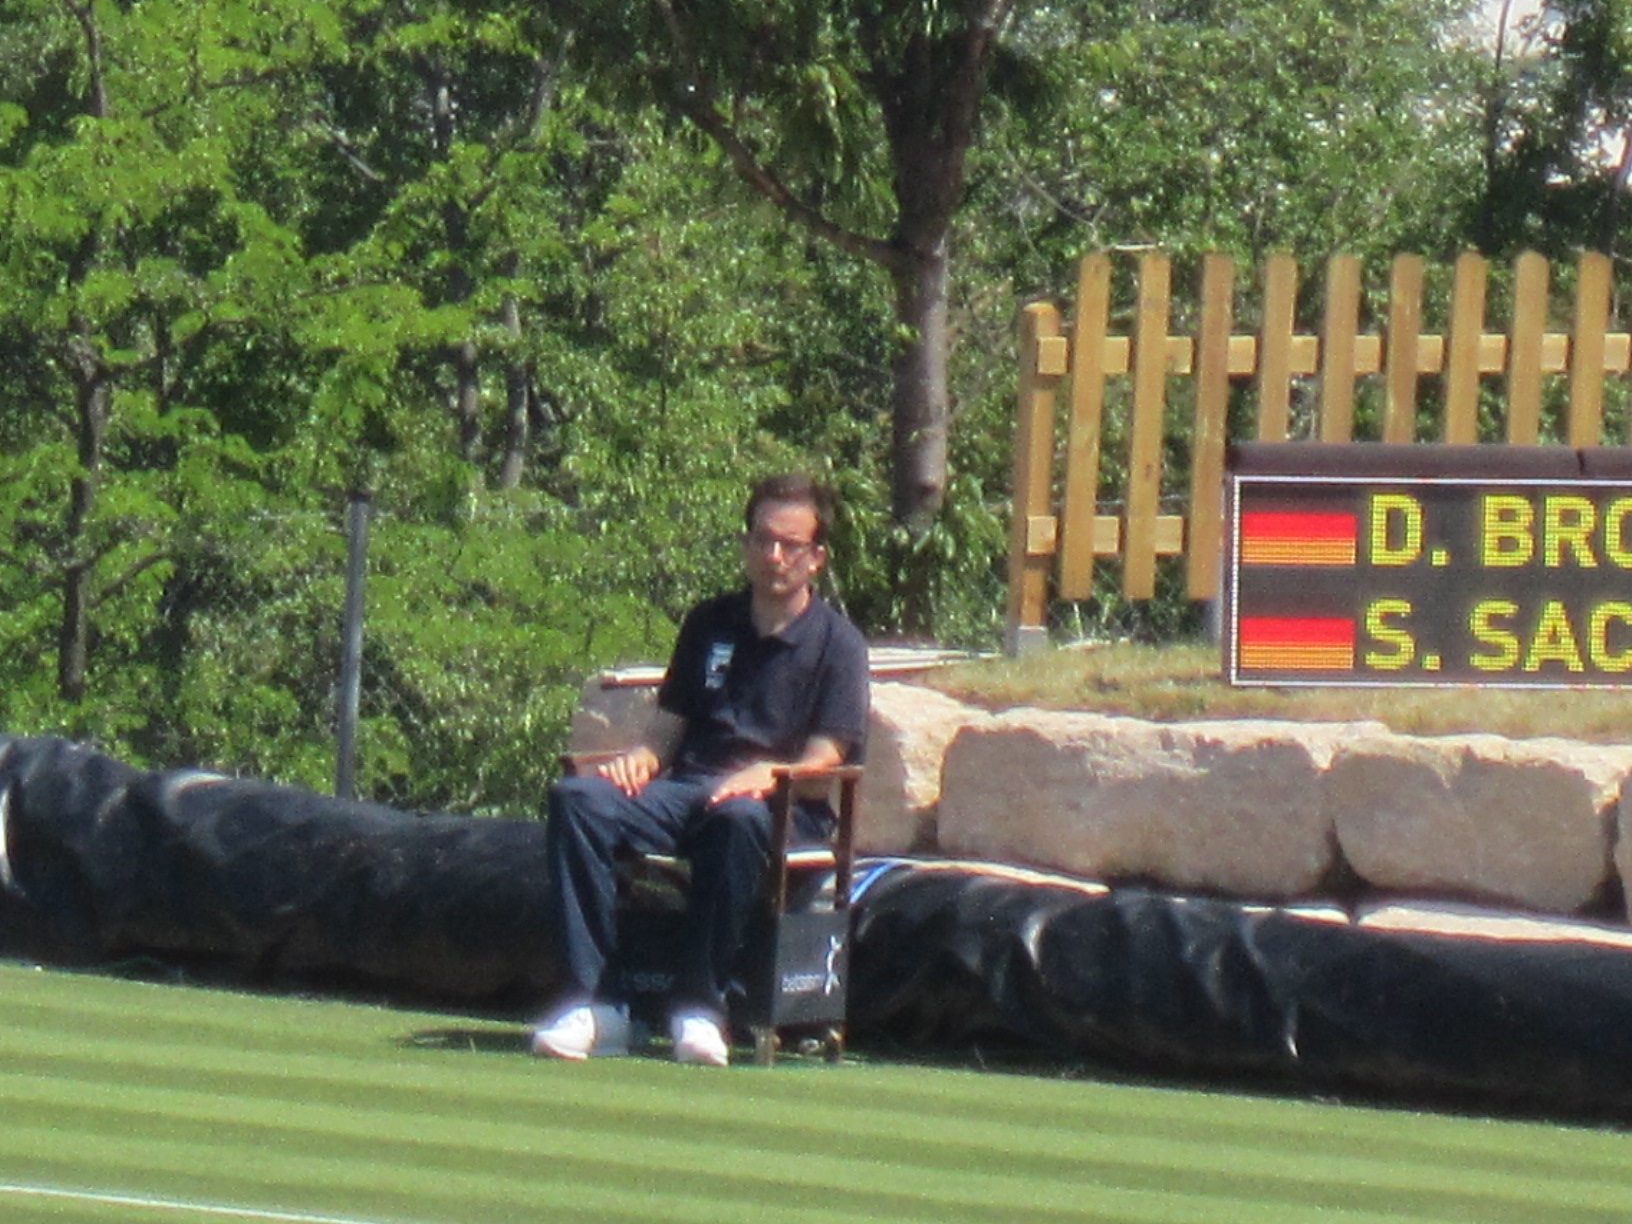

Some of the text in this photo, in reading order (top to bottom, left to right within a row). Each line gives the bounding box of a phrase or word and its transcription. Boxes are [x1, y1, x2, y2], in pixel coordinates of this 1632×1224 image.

[1371, 494, 1450, 567] D.
[1365, 598, 1632, 673] S. SAC
